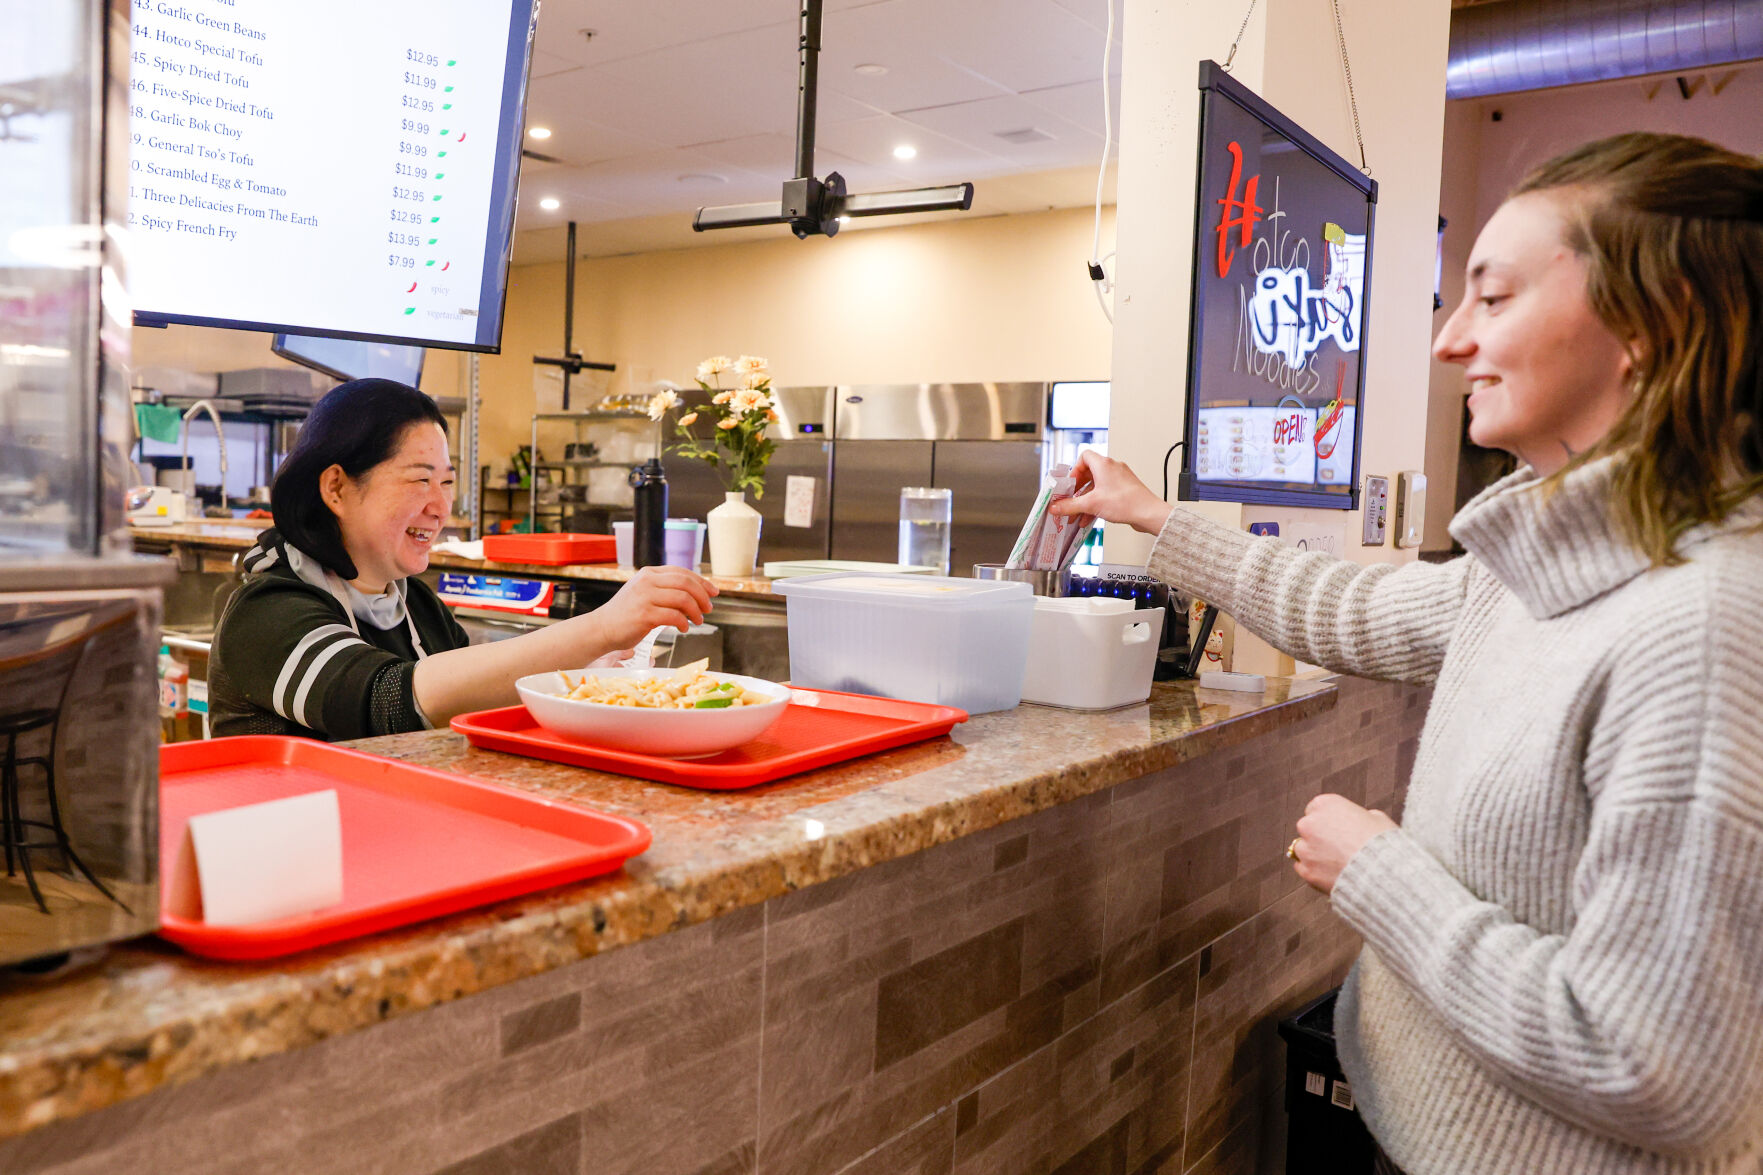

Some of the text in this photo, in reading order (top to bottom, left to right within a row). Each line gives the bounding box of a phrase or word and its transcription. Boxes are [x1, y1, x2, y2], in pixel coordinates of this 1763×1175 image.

[134, 0, 267, 41] 43. Garlic Green Beans
[132, 24, 263, 67] 44. Hotco Special Tofu
[406, 48, 439, 67] $12.95
[131, 51, 249, 89] 45. Spicy Dried Tofu
[404, 71, 437, 90] $11.99
[152, 82, 213, 106] Five-Spice
[215, 96, 246, 114] Dried
[249, 104, 274, 120] Tofu
[402, 94, 434, 113] $12.95
[150, 109, 186, 127] Garlic
[189, 117, 211, 132] Bok
[214, 122, 243, 141] Choy
[401, 118, 430, 135] $9.99
[129, 132, 144, 146] 9.
[148, 136, 194, 155] General
[229, 151, 254, 167] Tofu
[399, 141, 427, 157] $9.99
[146, 162, 208, 183] Scrambled
[211, 173, 231, 190] Egg
[233, 179, 243, 190] &
[246, 179, 287, 197] Tomato
[395, 162, 427, 179] $11.99
[392, 186, 425, 202] $12.95
[142, 187, 176, 204] Three
[179, 193, 234, 213] Delicacies
[237, 203, 266, 219] From
[268, 208, 288, 222] The
[290, 212, 319, 227] Earth
[390, 209, 422, 225] $12.95
[141, 214, 173, 232] Spicy
[176, 219, 215, 236] French
[218, 226, 237, 242] Fry
[388, 231, 420, 247] $13.95
[388, 254, 415, 269] $7.99
[431, 286, 450, 296] spicy
[427, 309, 464, 321] vegetarian
[1233, 283, 1320, 395] Noodles
[1107, 572, 1126, 581] SCAN
